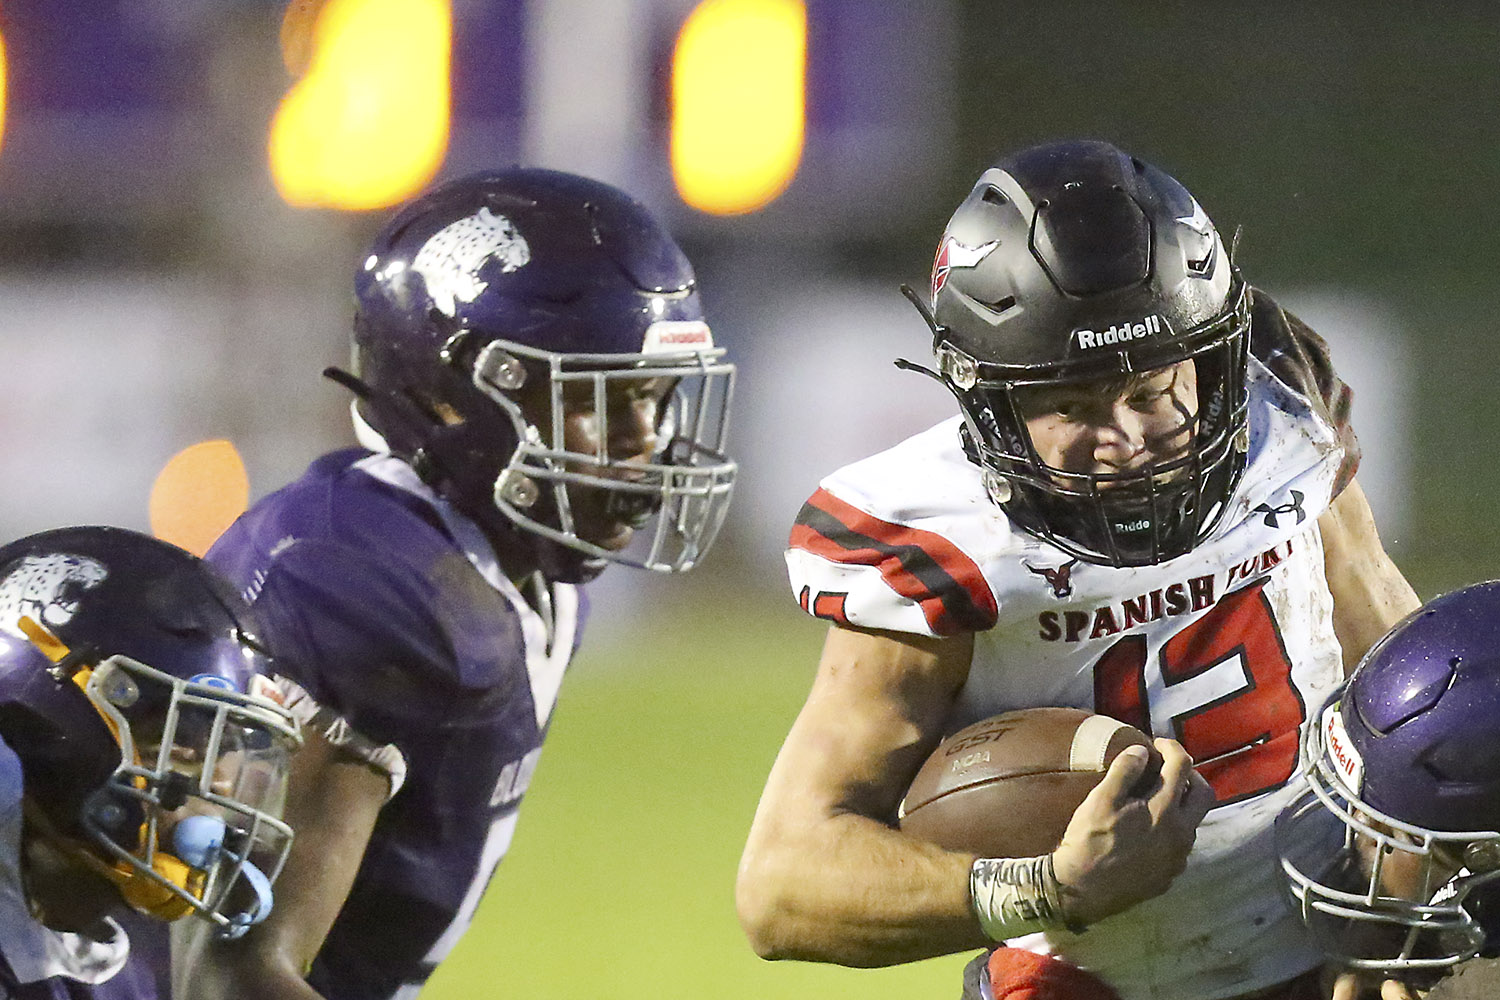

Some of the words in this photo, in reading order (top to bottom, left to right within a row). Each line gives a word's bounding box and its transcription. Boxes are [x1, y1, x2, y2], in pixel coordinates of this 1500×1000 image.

[1077, 314, 1160, 350] Riddell
[1038, 573, 1215, 642] SPANISH
[1093, 575, 1306, 812] 13
[1328, 716, 1355, 776] Riddell
